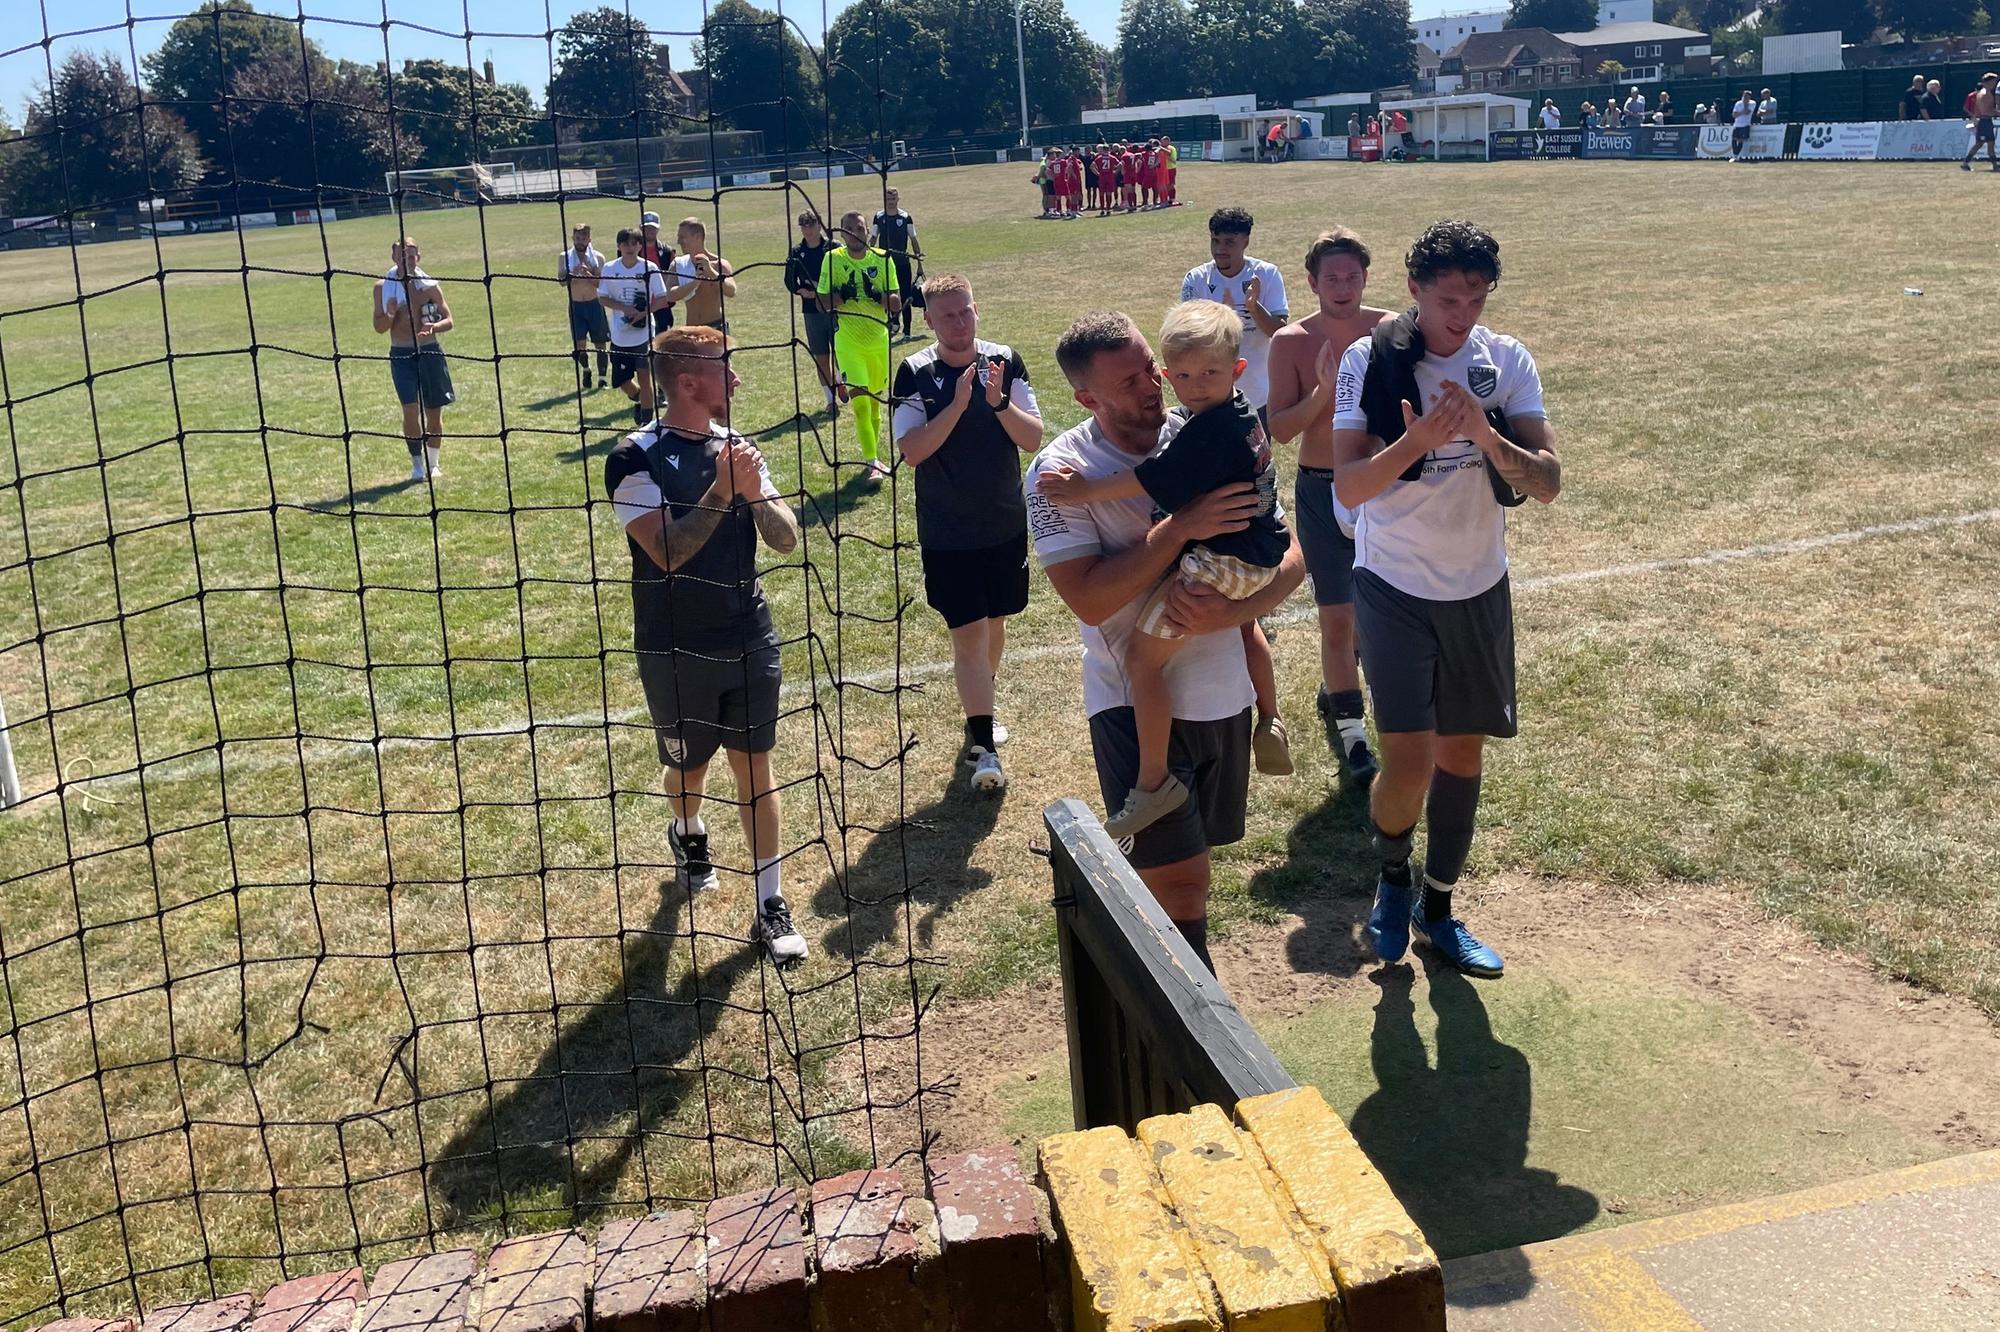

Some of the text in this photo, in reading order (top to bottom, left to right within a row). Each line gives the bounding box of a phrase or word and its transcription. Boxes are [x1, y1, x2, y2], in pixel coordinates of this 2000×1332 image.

[1545, 134, 1583, 143] EAST SUSSEX
[1587, 131, 1633, 150] Brewers
[1545, 144, 1572, 154] COLLEGE
[1910, 143, 1934, 153] RAM
[1102, 160, 1111, 170] 21
